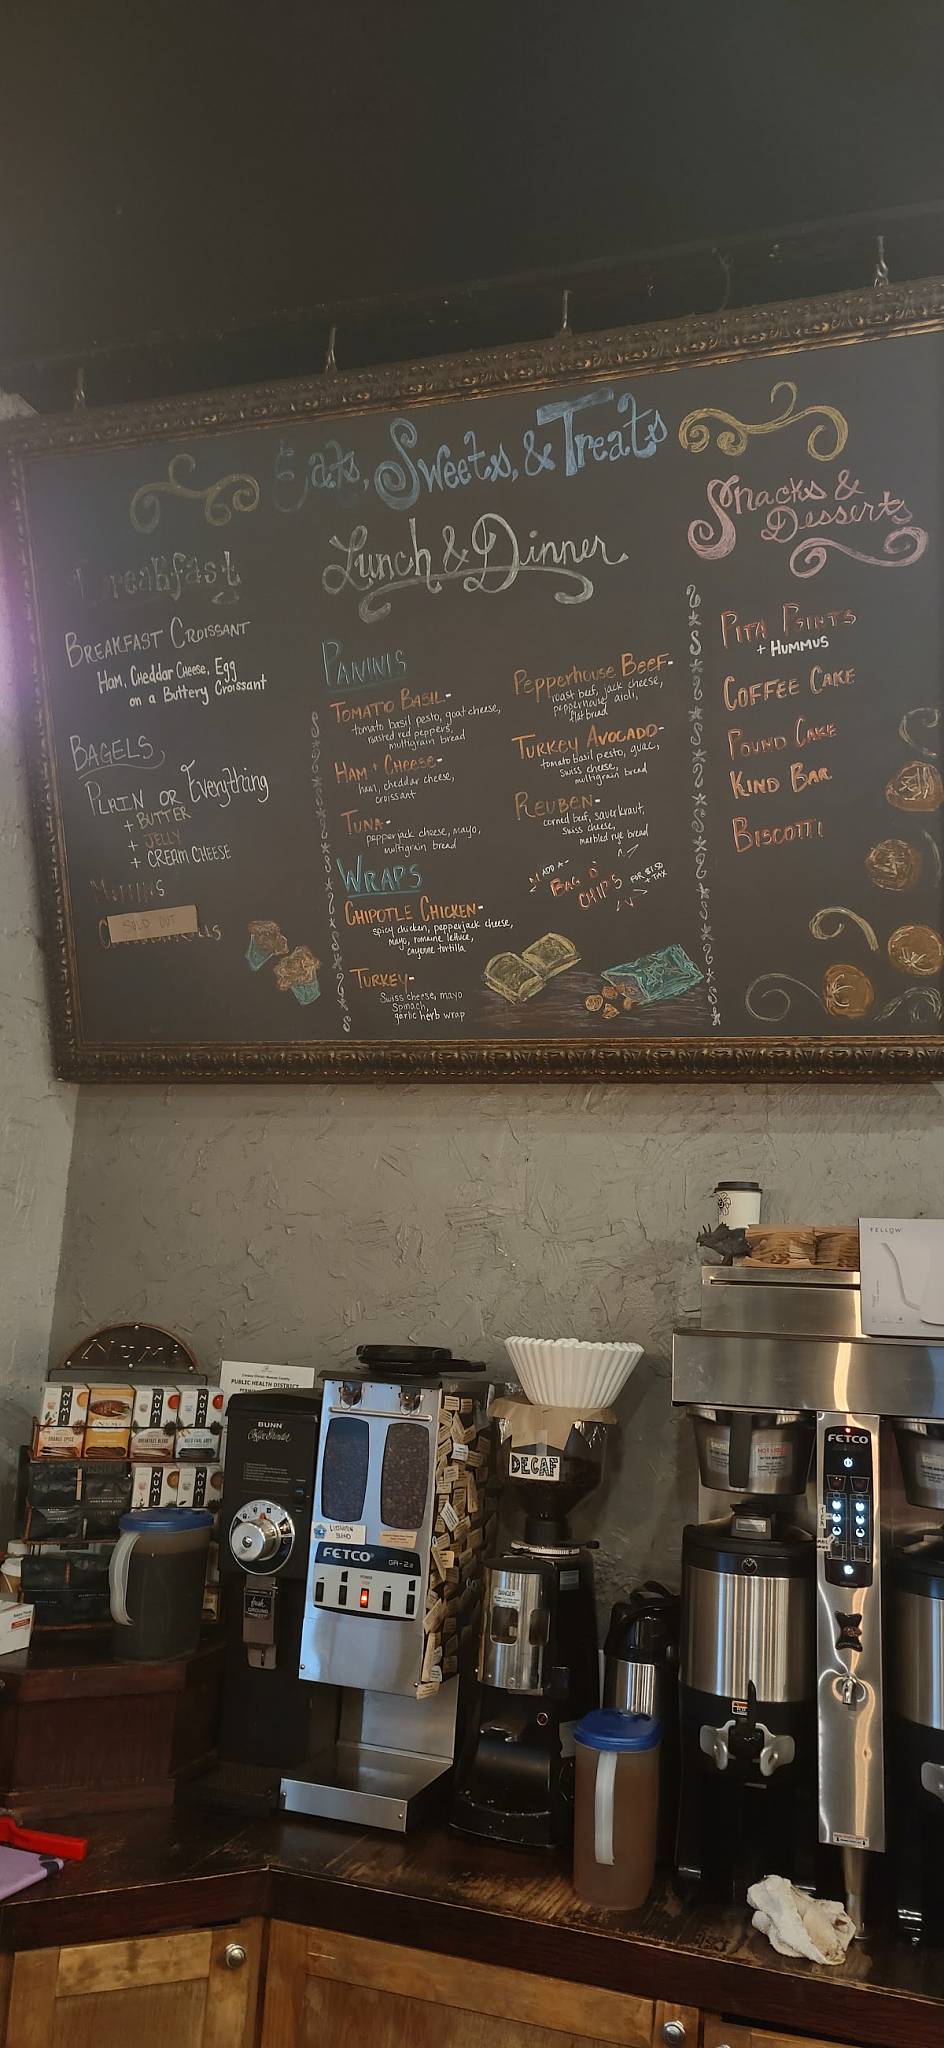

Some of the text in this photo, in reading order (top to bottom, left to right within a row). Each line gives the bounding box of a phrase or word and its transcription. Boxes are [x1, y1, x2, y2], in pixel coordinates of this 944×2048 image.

[537, 387, 667, 476] Treats
[374, 417, 518, 511] Sweets,
[524, 430, 557, 476] &
[688, 469, 865, 560] Snacks &
[760, 490, 913, 543] Desserts
[322, 512, 629, 594] Lunch & Dinner
[720, 610, 768, 648] PITA
[65, 617, 251, 668] BREAKFAST CROISSANT
[770, 636, 829, 656] HUMMUS
[214, 657, 237, 681] Egg
[321, 641, 406, 686] PANINIS
[129, 696, 142, 708] on
[163, 685, 208, 706] Buttery
[214, 674, 267, 696] Croissant
[513, 665, 616, 703] Pepperhouse
[603, 682, 622, 699] jack
[723, 665, 856, 711] COFFEE CAKE
[330, 701, 394, 723] TOMATO
[351, 722, 384, 736] tomato
[388, 714, 412, 731] basil
[445, 708, 466, 724] goat
[398, 727, 412, 739] red
[440, 731, 466, 744] bread
[727, 717, 837, 760] POUND CAKE
[70, 735, 154, 772] BAGELS
[540, 756, 570, 769] tomato
[572, 751, 593, 766] basil
[334, 761, 368, 784] HAM
[624, 763, 647, 776] bread
[729, 762, 832, 799] KIND BAR
[85, 759, 269, 816] PLAIN OR Everything
[383, 777, 421, 792] cheddar
[375, 791, 416, 804] croissant
[136, 806, 192, 830] BUTTER
[543, 814, 570, 828] corned
[627, 824, 649, 837] bread
[144, 830, 182, 848] JELLY
[732, 816, 823, 853] BISCOTTI
[191, 844, 231, 863] CHEESE
[336, 855, 422, 893] WRAPS
[344, 900, 413, 926] CHIPOTLE
[372, 925, 394, 938] spicy
[433, 920, 480, 935] pepperjack
[440, 990, 463, 1001] mayo
[394, 1010, 466, 1025] garlic herb wrap
[62, 1391, 71, 1421] NUMI
[511, 1454, 559, 1478] DECAF
[323, 1547, 370, 1562] FETCO
